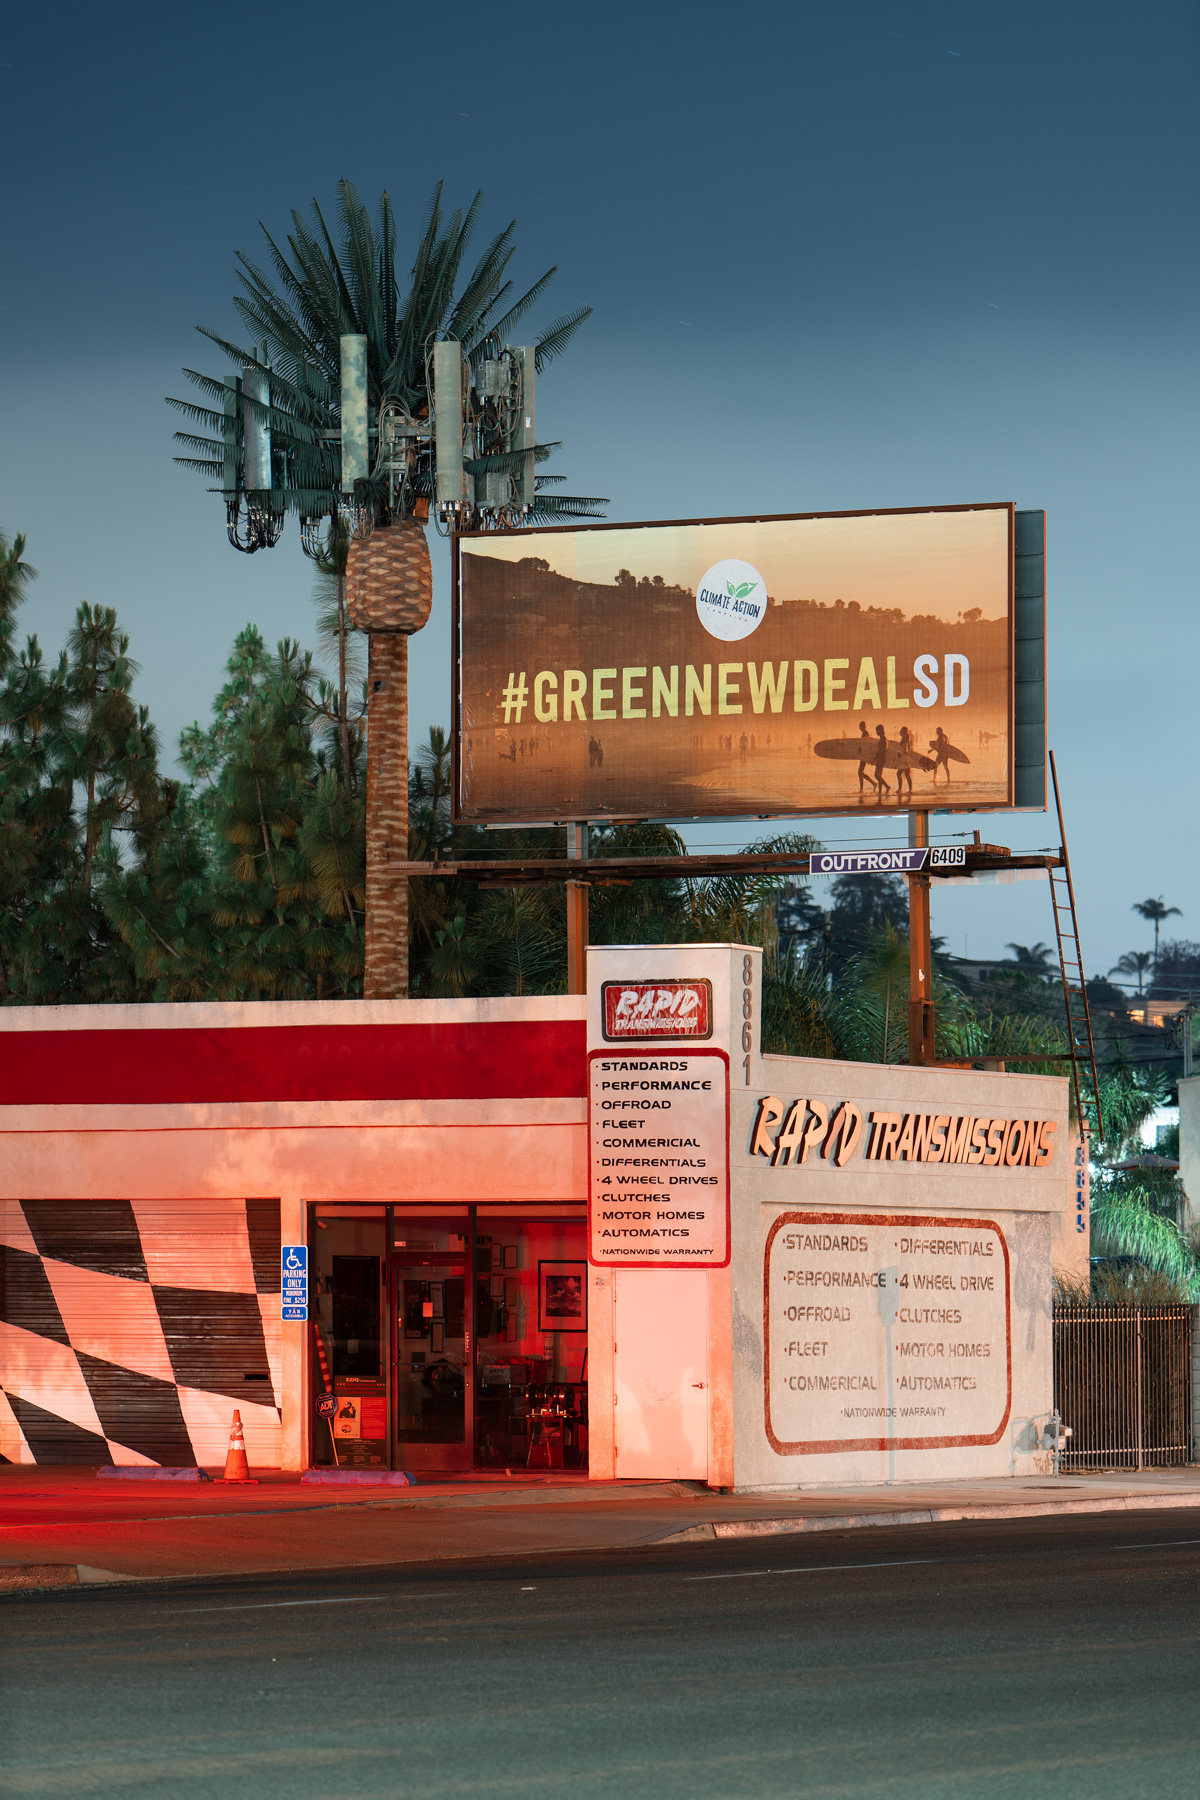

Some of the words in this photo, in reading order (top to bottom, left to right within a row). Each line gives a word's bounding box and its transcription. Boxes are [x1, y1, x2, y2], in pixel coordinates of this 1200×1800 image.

[700, 588, 731, 609] CLIMATE
[732, 599, 761, 619] ACTION
[501, 654, 970, 724] #GREENNEWDEALSD
[820, 852, 915, 871] OUTFRONT
[932, 848, 963, 864] 6409
[615, 989, 700, 1018] RAPID
[615, 1017, 699, 1030] TRANSMISSIONS
[742, 953, 753, 1086] 8861
[601, 1061, 688, 1071] STANDARDS
[602, 1081, 712, 1090] PERFORMANCE
[601, 1100, 672, 1110] OFFROAD
[602, 1120, 646, 1129] FLEET
[750, 1096, 862, 1167] RAPID
[866, 1111, 1057, 1167] TRANSMISSIONS
[602, 1139, 700, 1148] COMMERICIAL
[601, 1158, 706, 1167] DIFFERENTIALS
[601, 1176, 612, 1185] 4
[616, 1176, 665, 1184] WHEEL
[669, 1176, 718, 1185] DRIVES
[602, 1194, 671, 1202] CLUTCHES
[602, 1211, 651, 1220] MOTOR
[657, 1211, 705, 1220] HOMES
[601, 1229, 690, 1237] AUTOMATICS
[786, 1234, 868, 1252] STANDARDS
[900, 1238, 994, 1257] DIFFERENTIALS
[283, 1269, 306, 1279] PARKING
[787, 1270, 887, 1288] PERFORMANCE
[287, 1279, 302, 1288] ONLY
[900, 1273, 909, 1289] 4
[912, 1275, 956, 1290] WHEEL
[960, 1276, 994, 1291] DRIVE
[787, 1306, 851, 1321] OFFROAD
[899, 1308, 962, 1324] CLUTCHES
[788, 1341, 828, 1357] FLEET
[900, 1343, 944, 1357] MOTOR
[949, 1343, 990, 1358] HOMES
[789, 1375, 877, 1391] COMMERICIAL
[900, 1376, 977, 1391] AUTOMATICS
[320, 1400, 333, 1412] ADT
[843, 1407, 897, 1418] NATIONWIDE
[900, 1406, 946, 1417] WARRANTY
